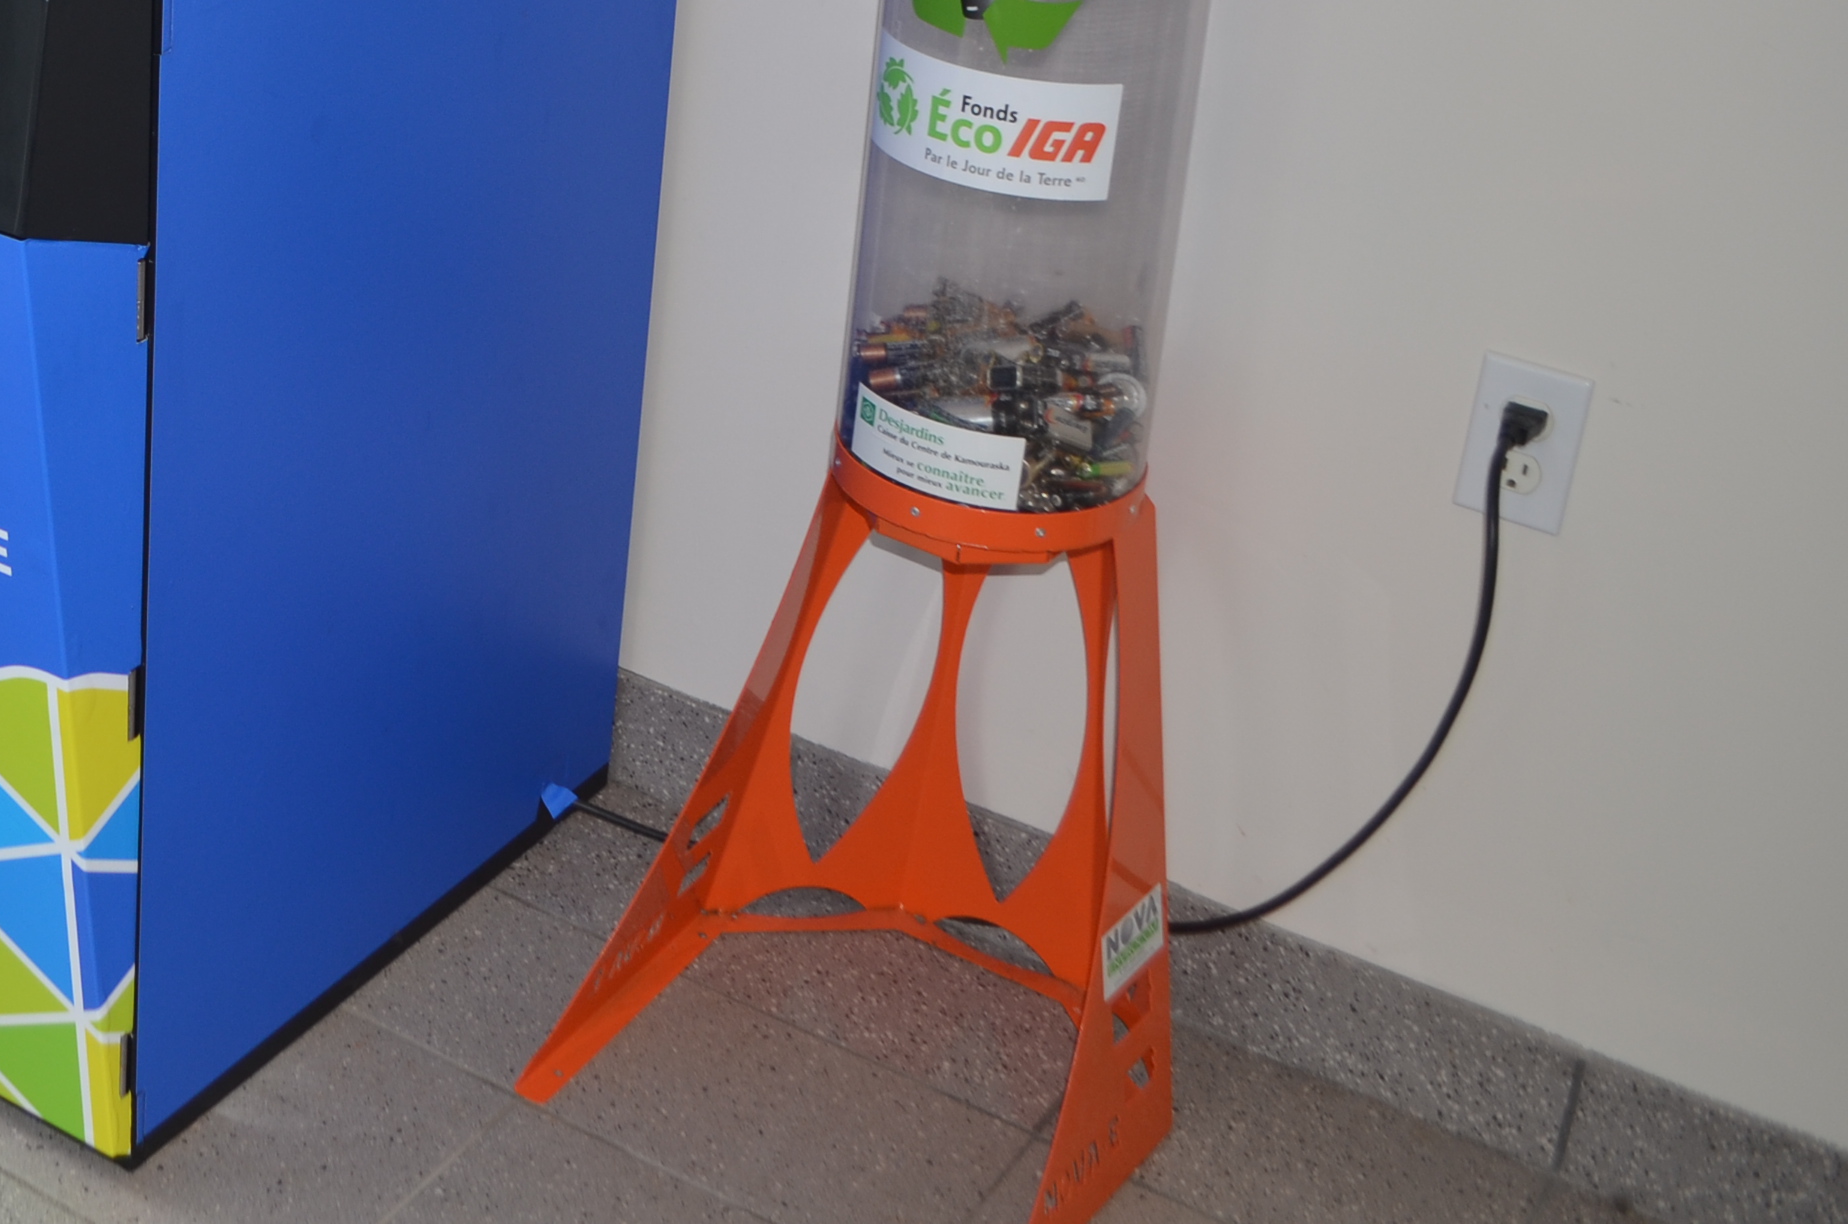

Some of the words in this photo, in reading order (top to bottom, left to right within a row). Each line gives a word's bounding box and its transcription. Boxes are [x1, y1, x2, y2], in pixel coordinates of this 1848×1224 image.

[927, 88, 1002, 154] Éco
[1007, 118, 1106, 163] IGA
[961, 94, 1018, 123] Fonds
[924, 147, 943, 164] Par
[946, 155, 958, 169] le
[961, 159, 992, 177] Jour
[996, 167, 1014, 181] de
[1019, 170, 1031, 184] la
[1037, 172, 1072, 187] Terre
[878, 409, 945, 445] Desjardins
[899, 436, 909, 447] du
[911, 441, 939, 457] Centre
[940, 451, 952, 460] de
[954, 454, 1010, 471] Kamouraska
[896, 466, 915, 479] pour
[916, 475, 943, 488] mieux
[905, 459, 915, 468] se
[916, 462, 986, 487] connaître
